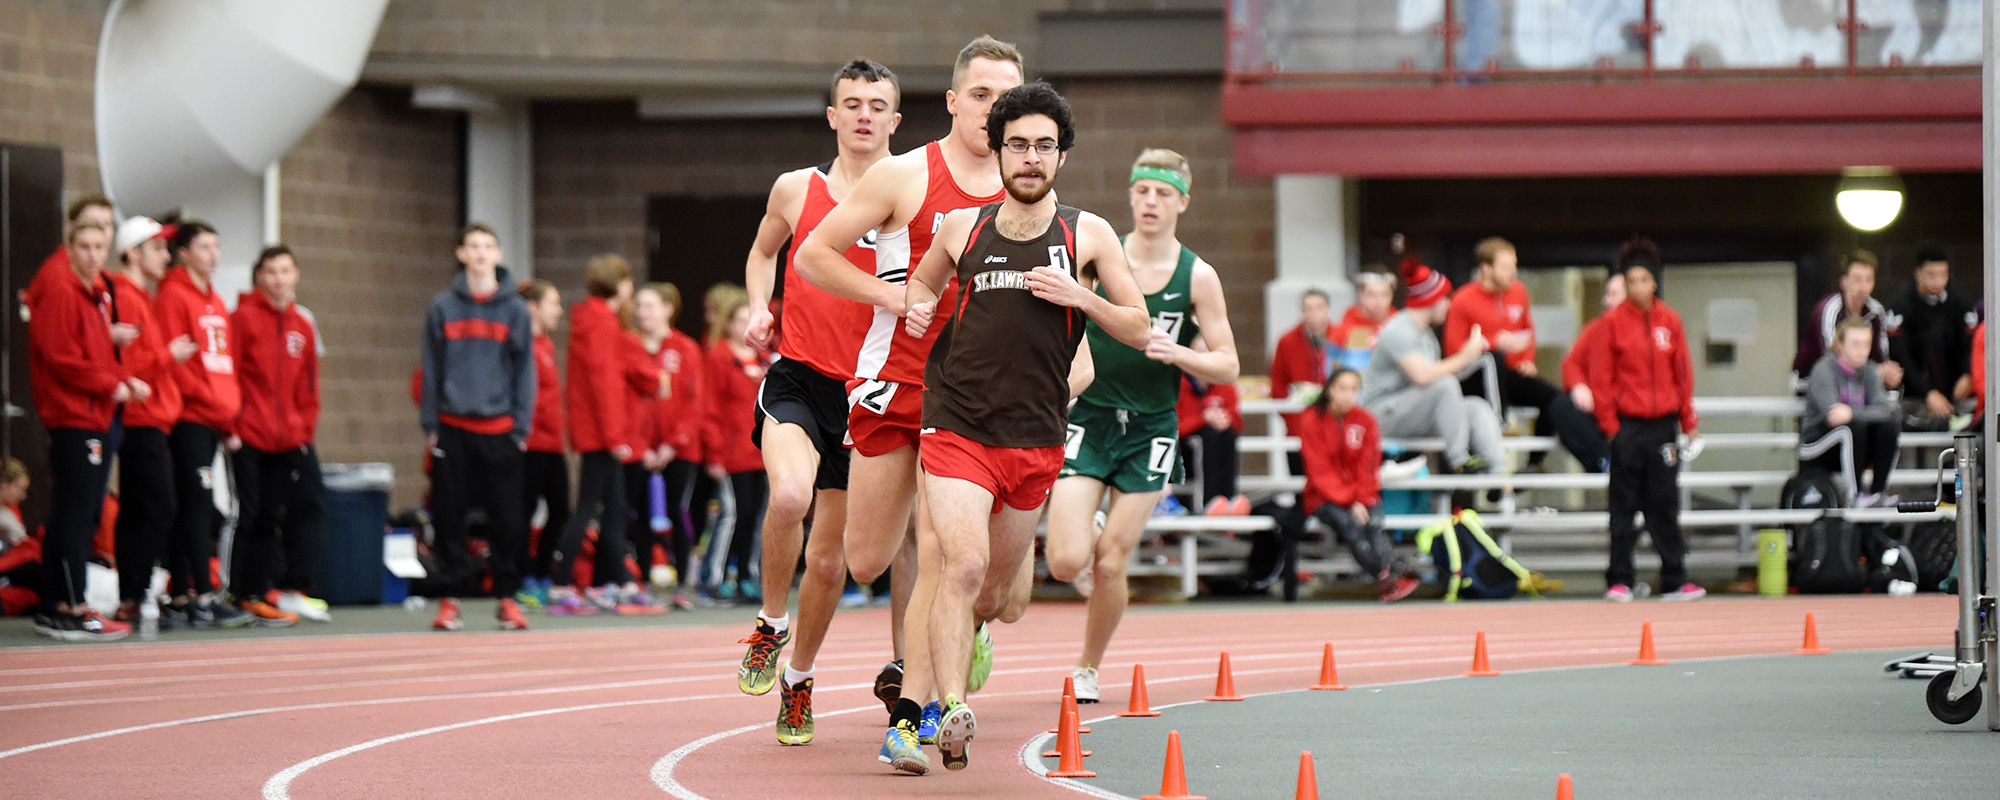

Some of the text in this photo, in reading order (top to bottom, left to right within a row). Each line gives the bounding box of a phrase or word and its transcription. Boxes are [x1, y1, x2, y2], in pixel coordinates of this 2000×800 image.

[1053, 248, 1066, 270] 1
[973, 271, 990, 293] ST.
[1163, 315, 1181, 334] 7
[862, 379, 894, 412] 2
[1065, 428, 1079, 447] 7
[1156, 440, 1173, 469] 7
